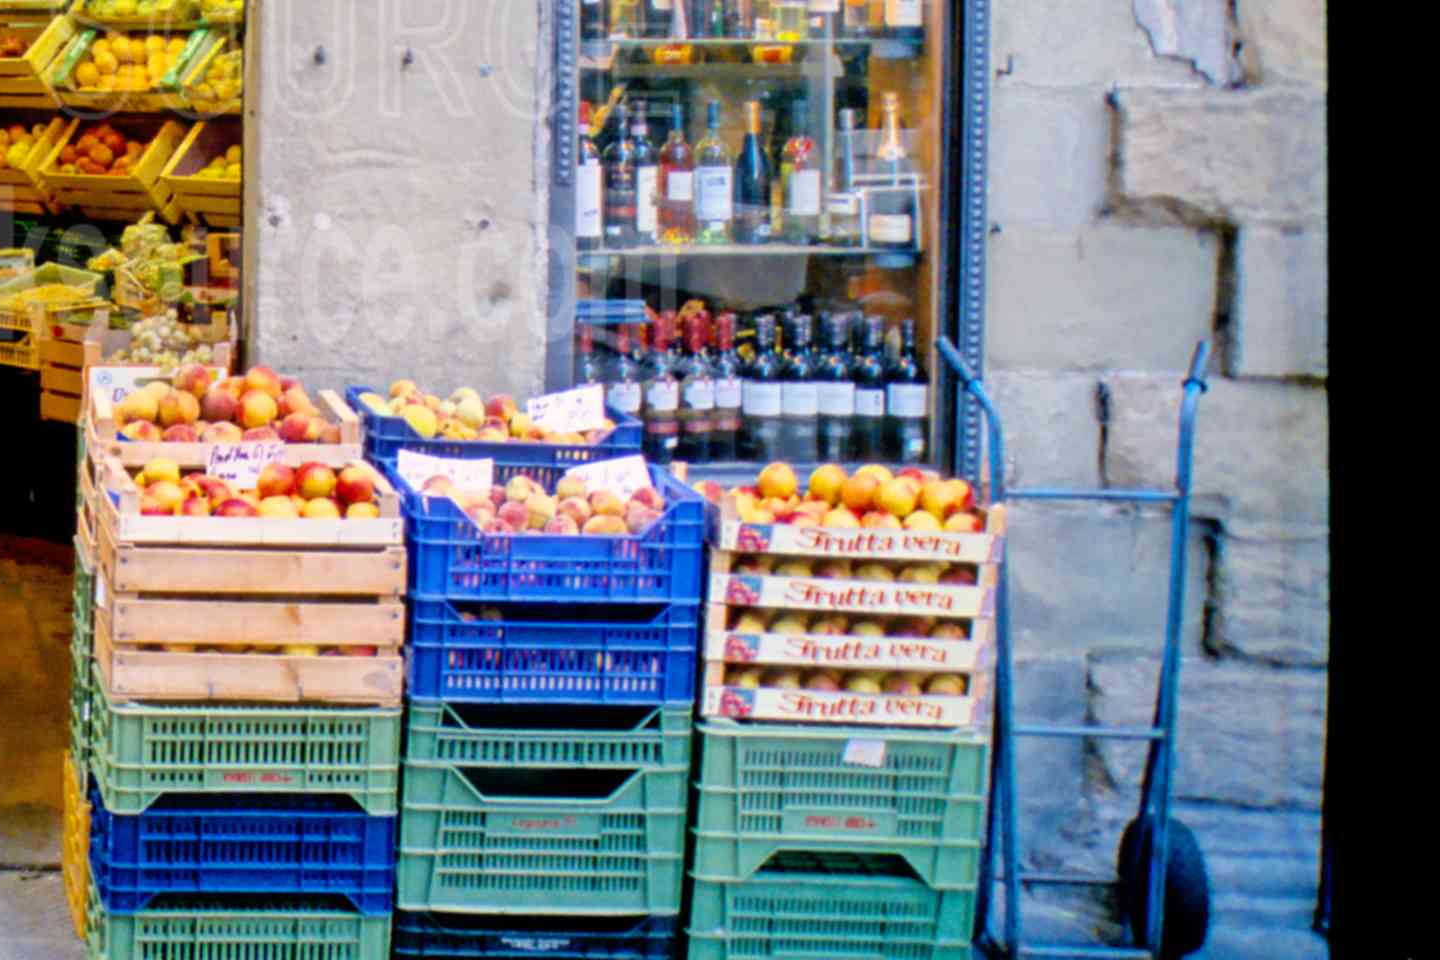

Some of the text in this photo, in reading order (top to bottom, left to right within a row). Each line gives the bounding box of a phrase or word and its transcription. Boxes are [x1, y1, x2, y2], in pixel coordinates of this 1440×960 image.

[796, 526, 894, 552] Frutta
[785, 580, 886, 607] Frutta
[784, 637, 881, 660] Frutta
[778, 692, 876, 717] Frutta
